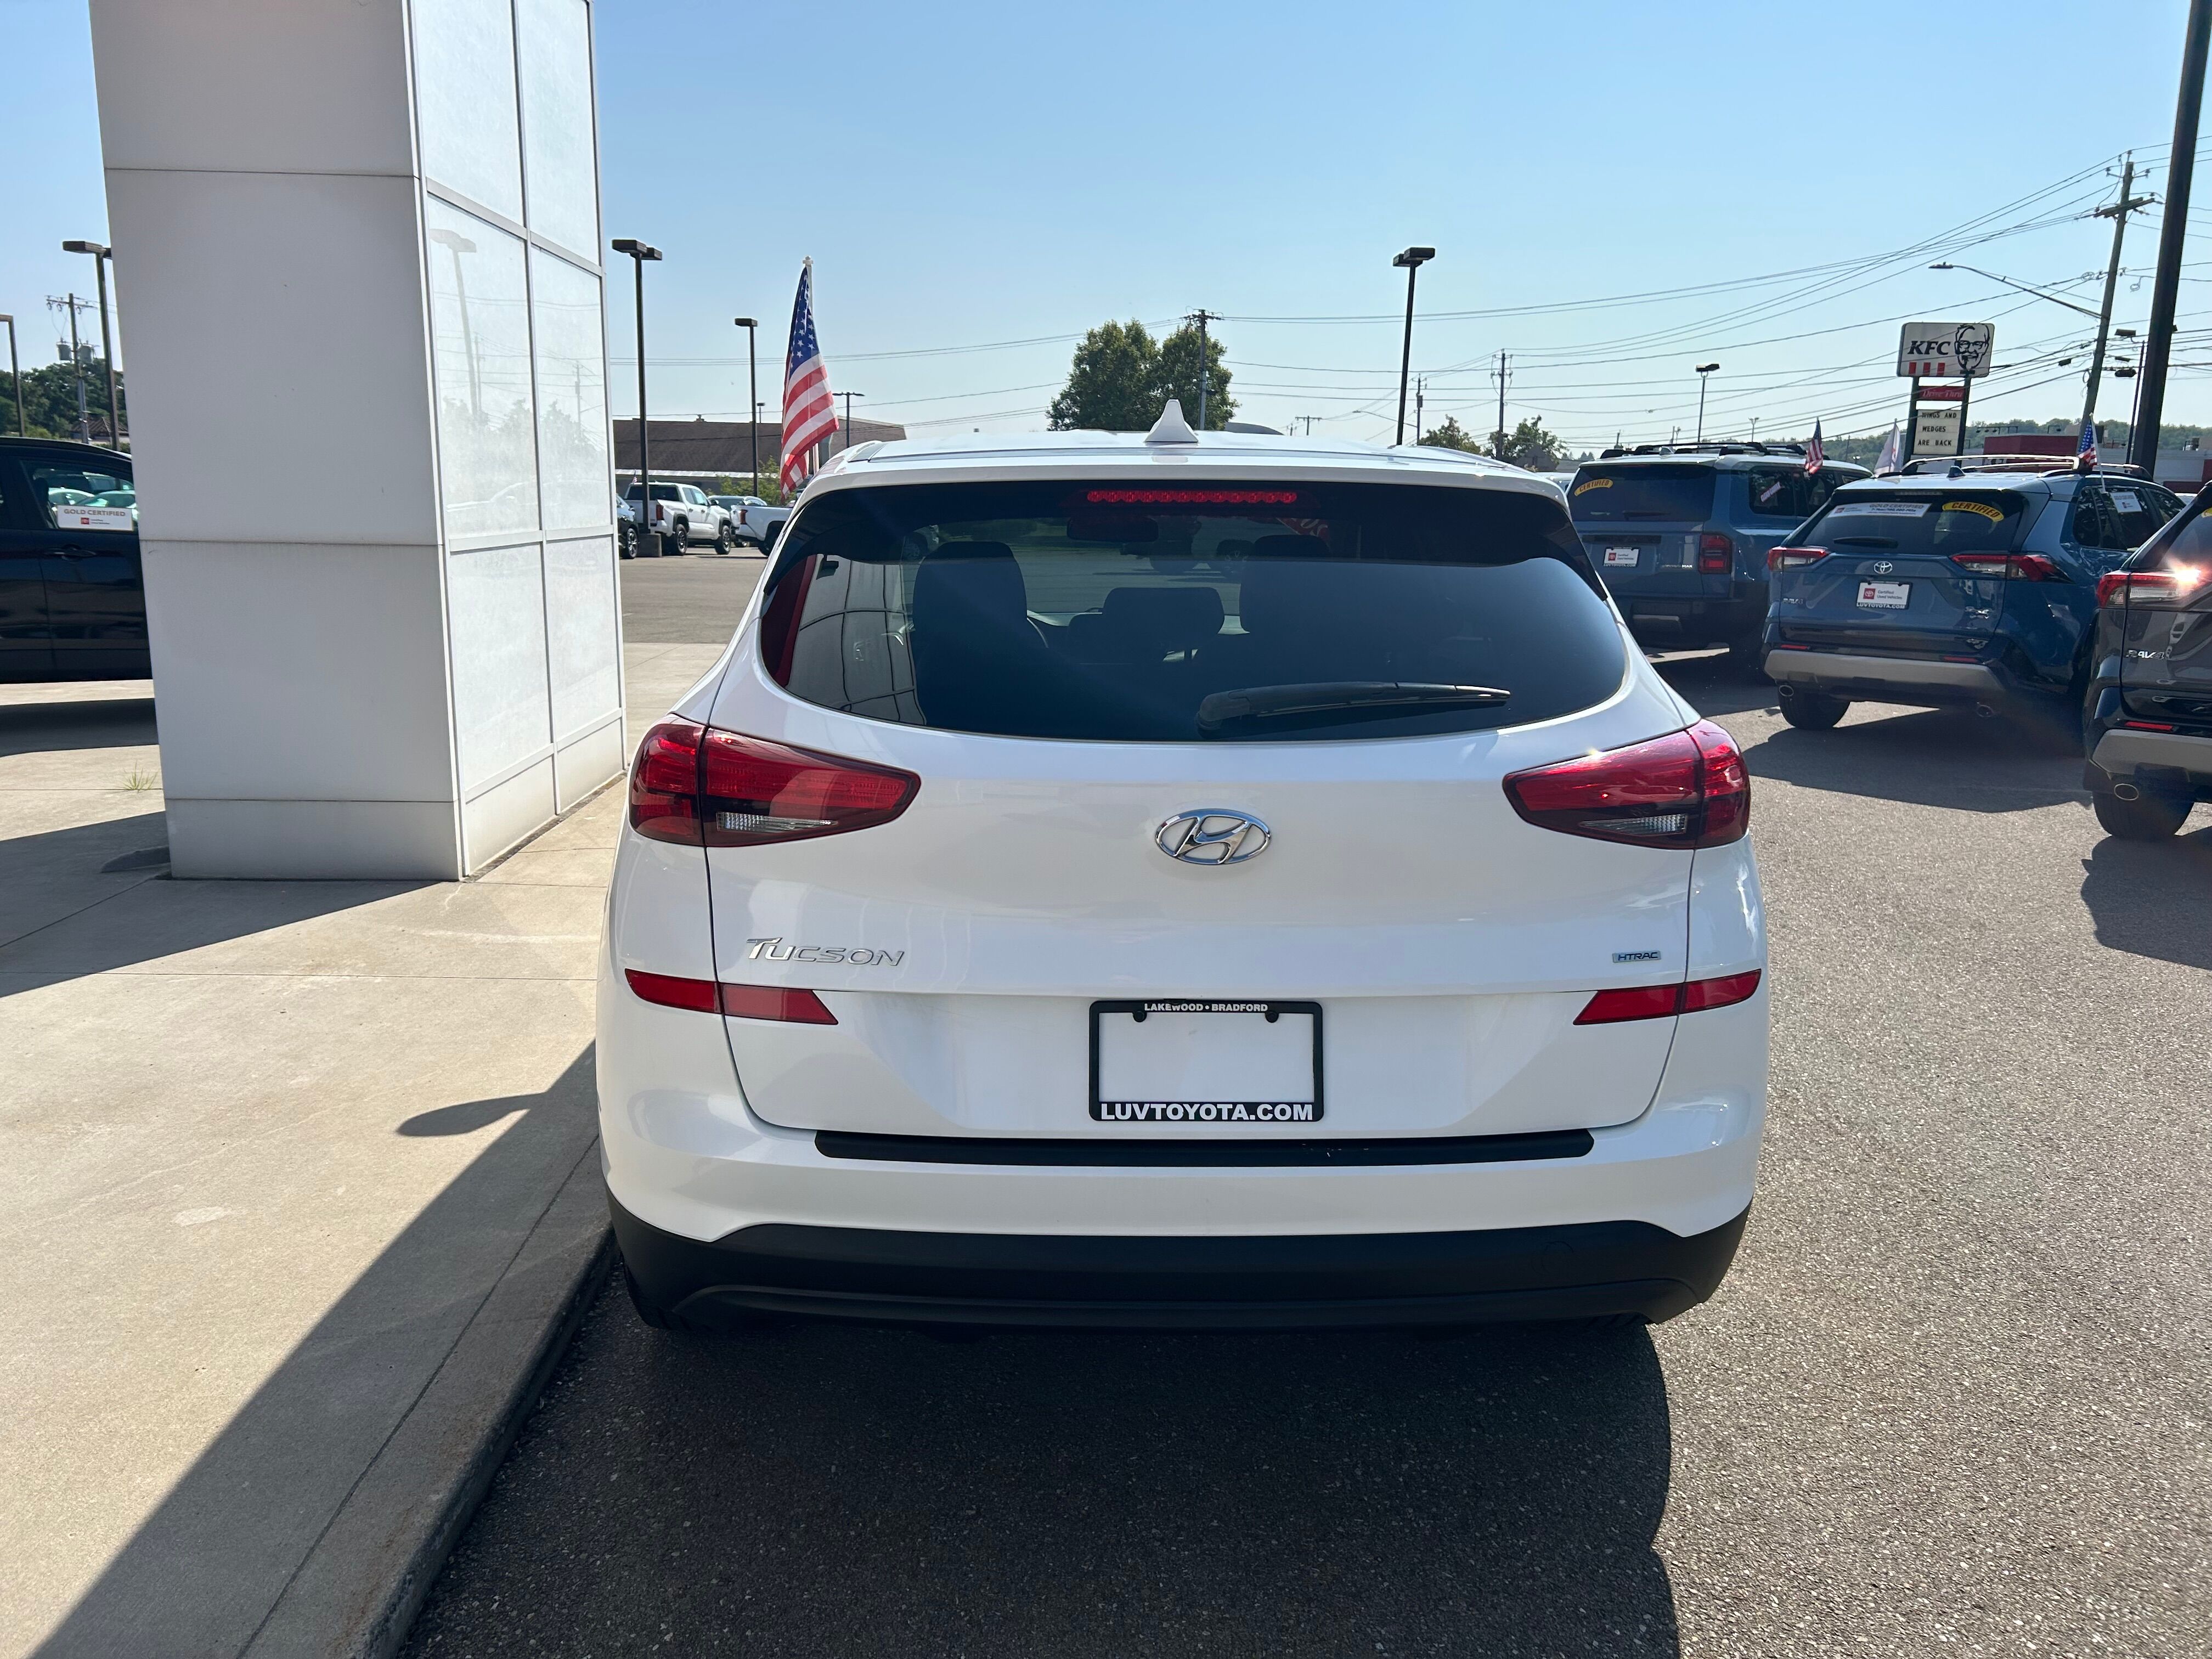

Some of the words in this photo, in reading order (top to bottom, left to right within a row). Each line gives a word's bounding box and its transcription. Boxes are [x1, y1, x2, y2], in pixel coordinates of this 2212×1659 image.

[1908, 340, 1951, 355] KFC
[1579, 479, 1610, 492] CERTIFIED
[1951, 502, 2001, 518] CERTIFIED
[2125, 650, 2165, 660] RAV4
[746, 937, 905, 966] TUCSON
[1617, 952, 1658, 961] HTRAC
[1144, 1003, 1204, 1012] LAKEWOOD
[1211, 1003, 1268, 1012] BRADFORD
[1101, 1103, 1313, 1121] LUVTOYOTA.COM
